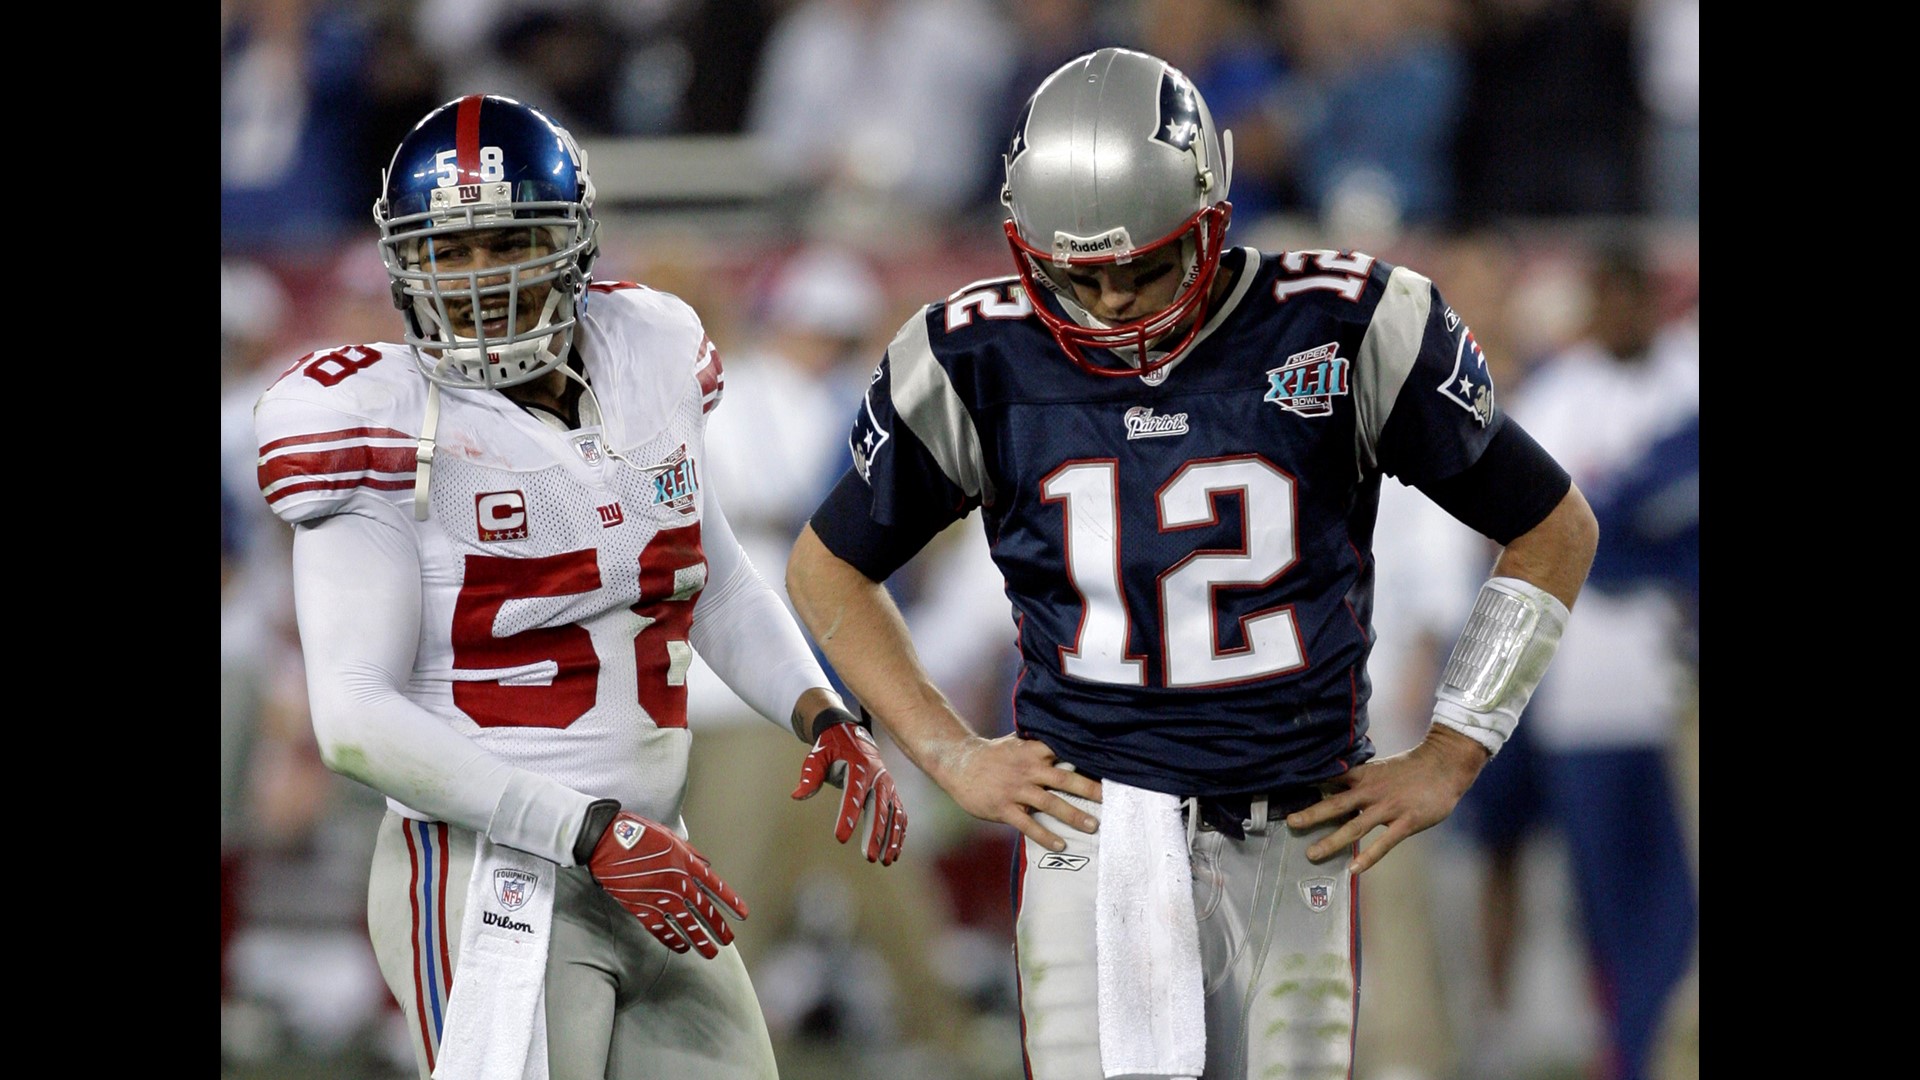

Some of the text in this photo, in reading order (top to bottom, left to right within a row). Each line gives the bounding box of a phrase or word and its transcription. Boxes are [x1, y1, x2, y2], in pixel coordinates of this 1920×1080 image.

[1070, 235, 1112, 252] Riddell
[1292, 348, 1328, 363] SUPER
[1265, 360, 1342, 399] XLII
[1292, 397, 1321, 406] BOWL
[1128, 413, 1187, 438] Patriots
[478, 492, 525, 531] C
[596, 501, 624, 529] ny
[1039, 453, 1309, 688] 12
[451, 521, 708, 729] 58
[496, 871, 535, 883] EQUIPMENT
[503, 889, 523, 905] NFL
[482, 910, 533, 934] Wilson
